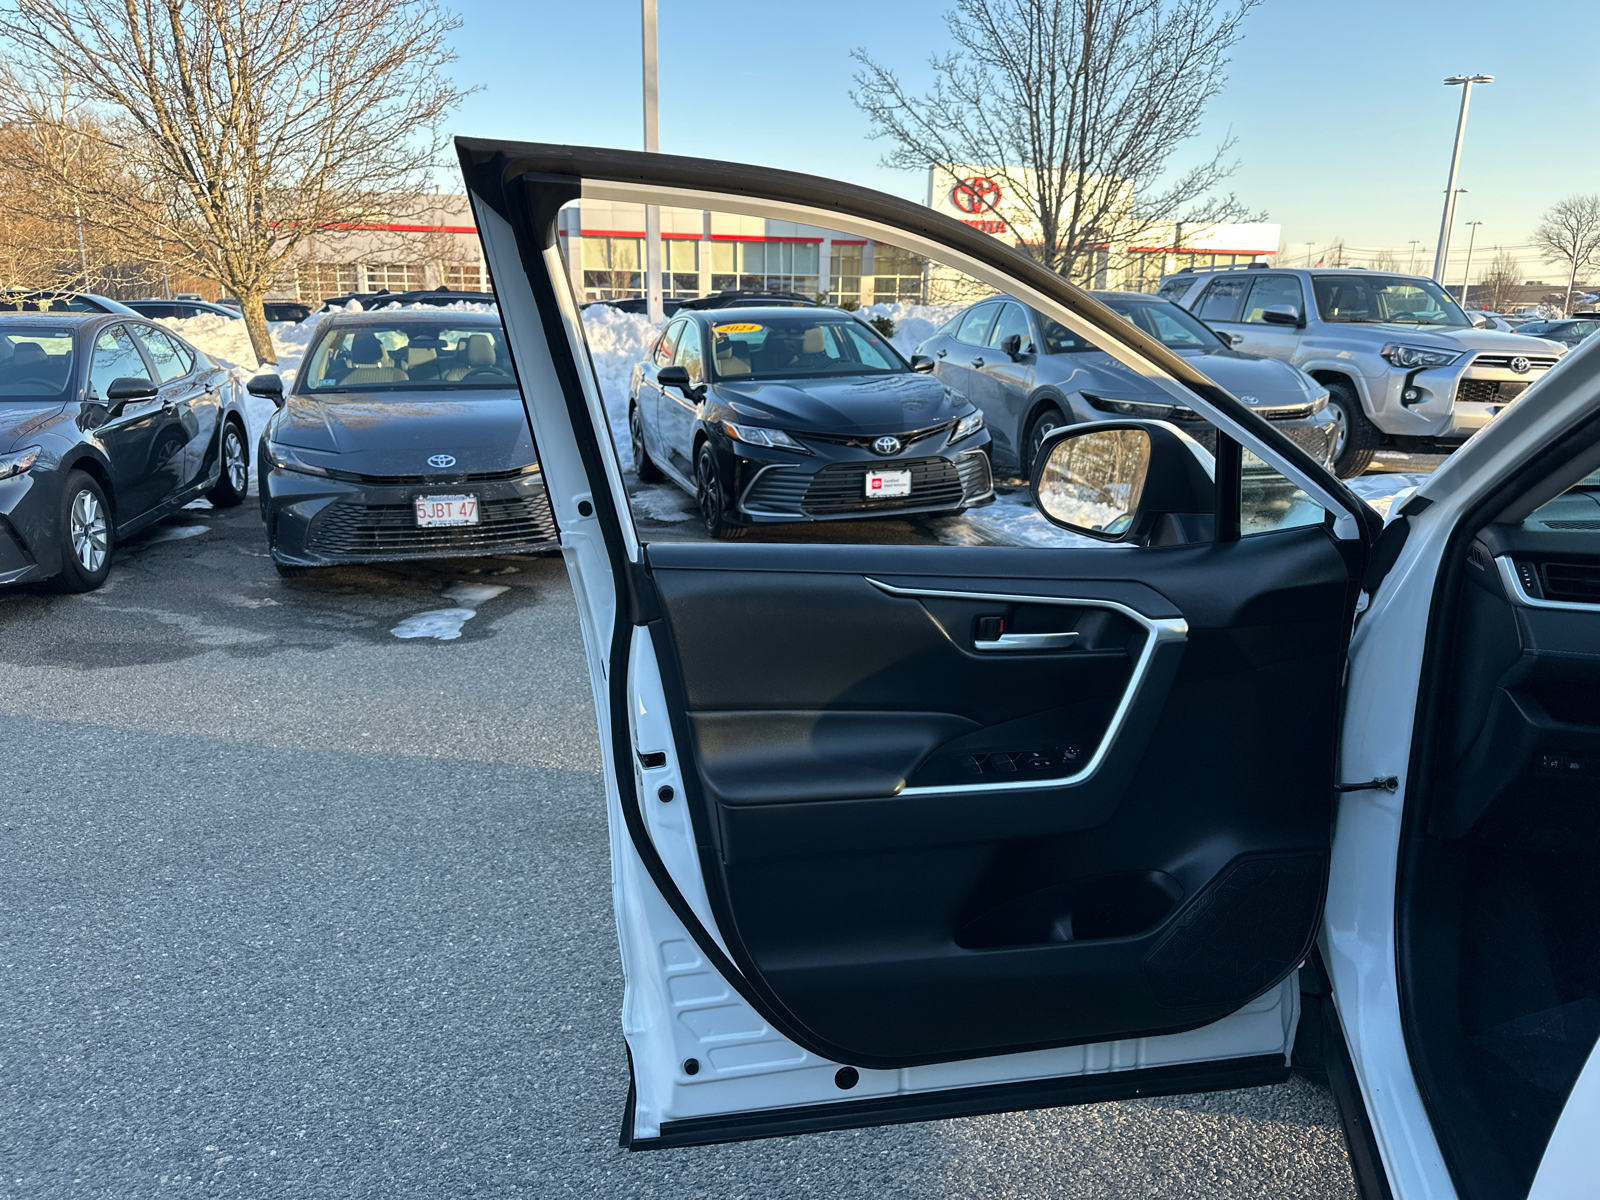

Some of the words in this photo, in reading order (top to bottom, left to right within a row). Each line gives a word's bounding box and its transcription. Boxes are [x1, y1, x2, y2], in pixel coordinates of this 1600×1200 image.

[722, 324, 756, 332] 2024
[417, 503, 453, 519] 5JBT
[459, 501, 476, 517] 47
[1184, 896, 1208, 922] RAV4
